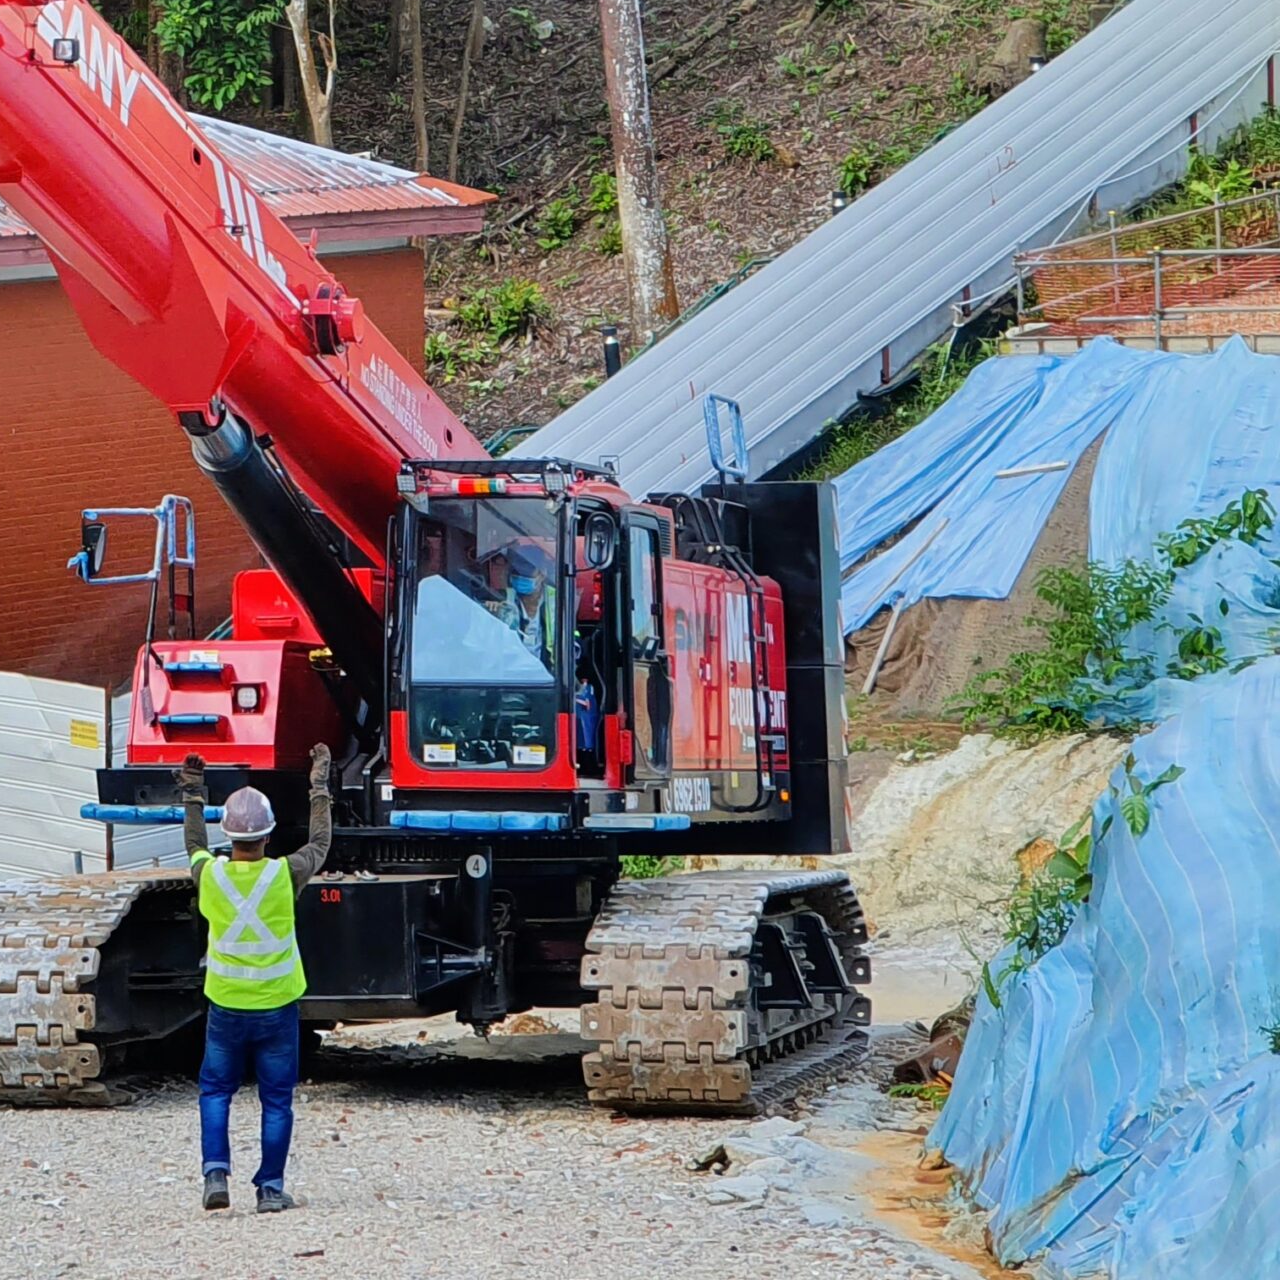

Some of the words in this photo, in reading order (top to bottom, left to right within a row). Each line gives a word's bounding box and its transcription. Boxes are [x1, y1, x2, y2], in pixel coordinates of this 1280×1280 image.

[37, 0, 140, 127] SANY
[729, 687, 785, 728] EQUIMENT
[472, 858, 479, 874] 4
